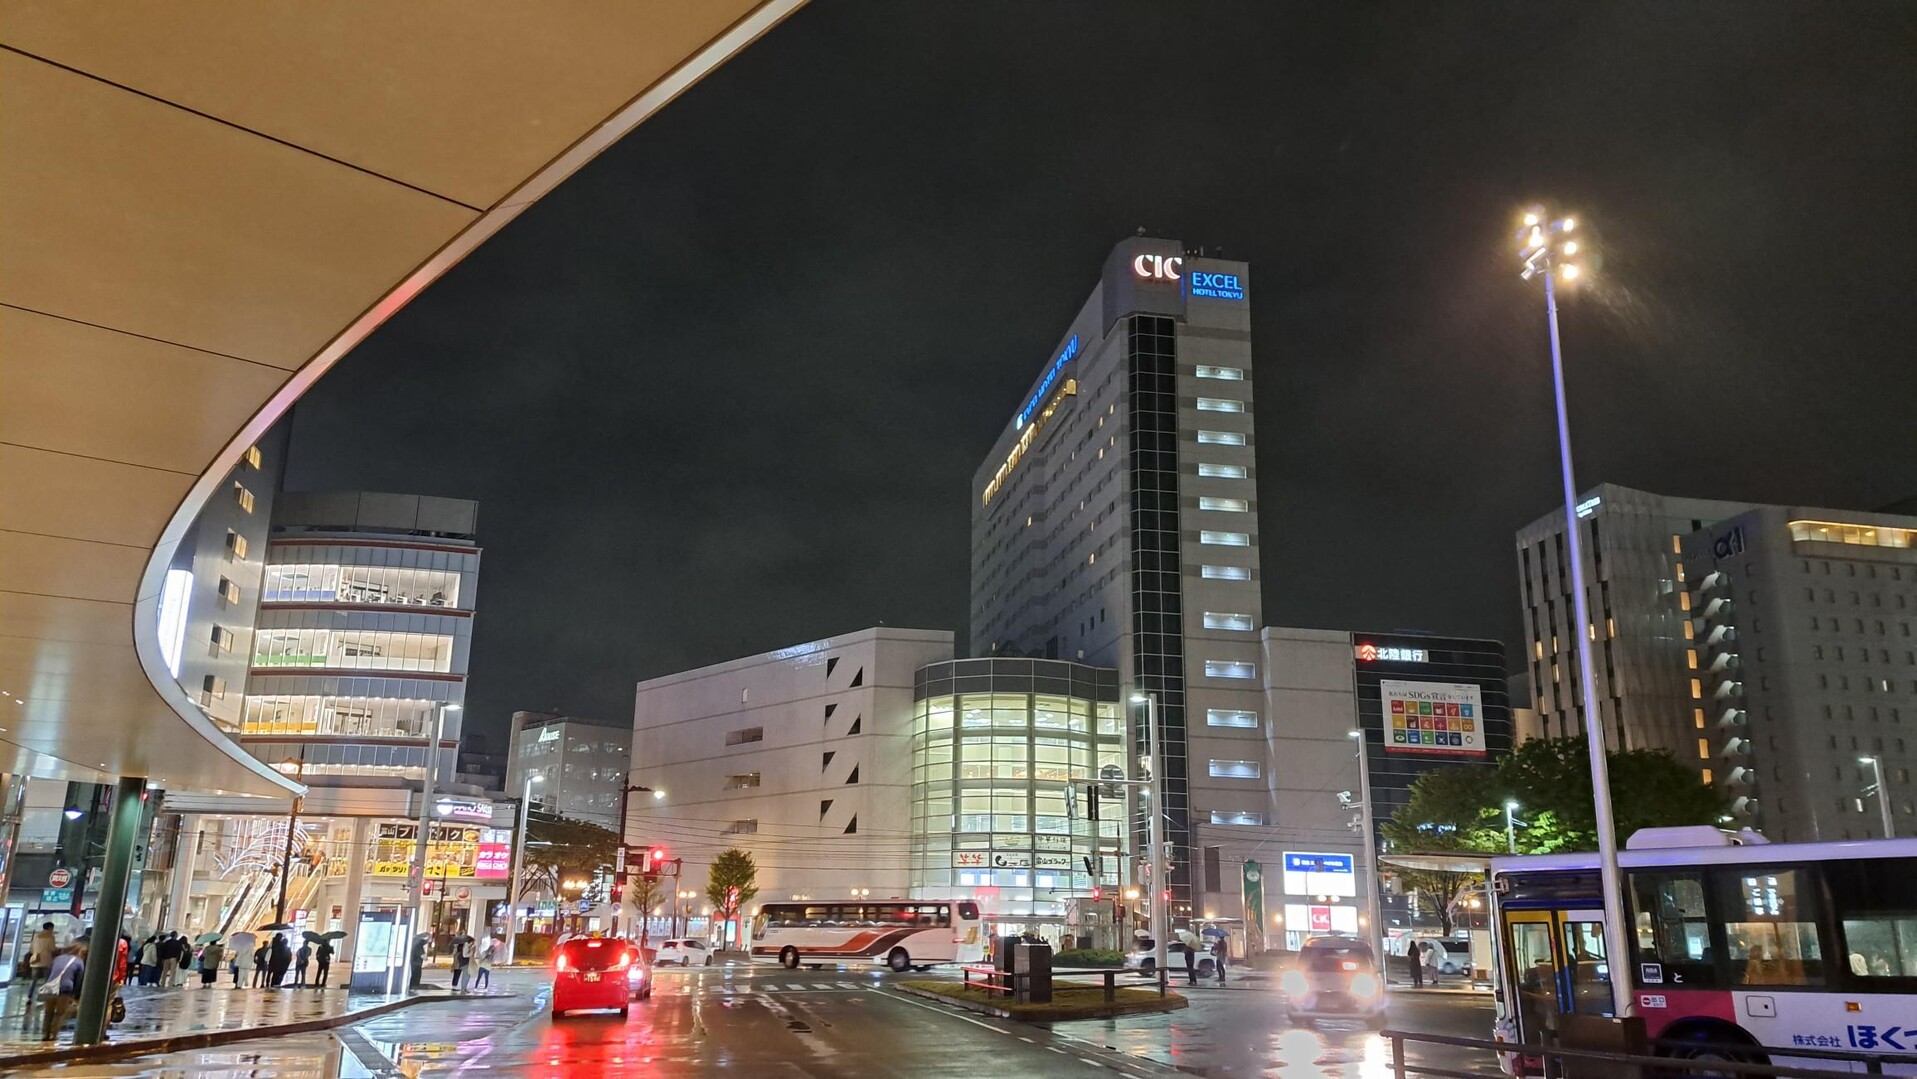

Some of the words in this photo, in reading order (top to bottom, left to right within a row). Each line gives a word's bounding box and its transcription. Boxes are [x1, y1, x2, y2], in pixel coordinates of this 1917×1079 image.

[1192, 272, 1242, 290] EXCEL
[1192, 288, 1217, 297] HOTEL
[1217, 290, 1243, 299] TOKYU
[1377, 648, 1424, 662] 北陸銀行
[478, 851, 508, 859] カラオケ
[1673, 972, 1684, 983] と
[1792, 1034, 1842, 1048] 株式会社
